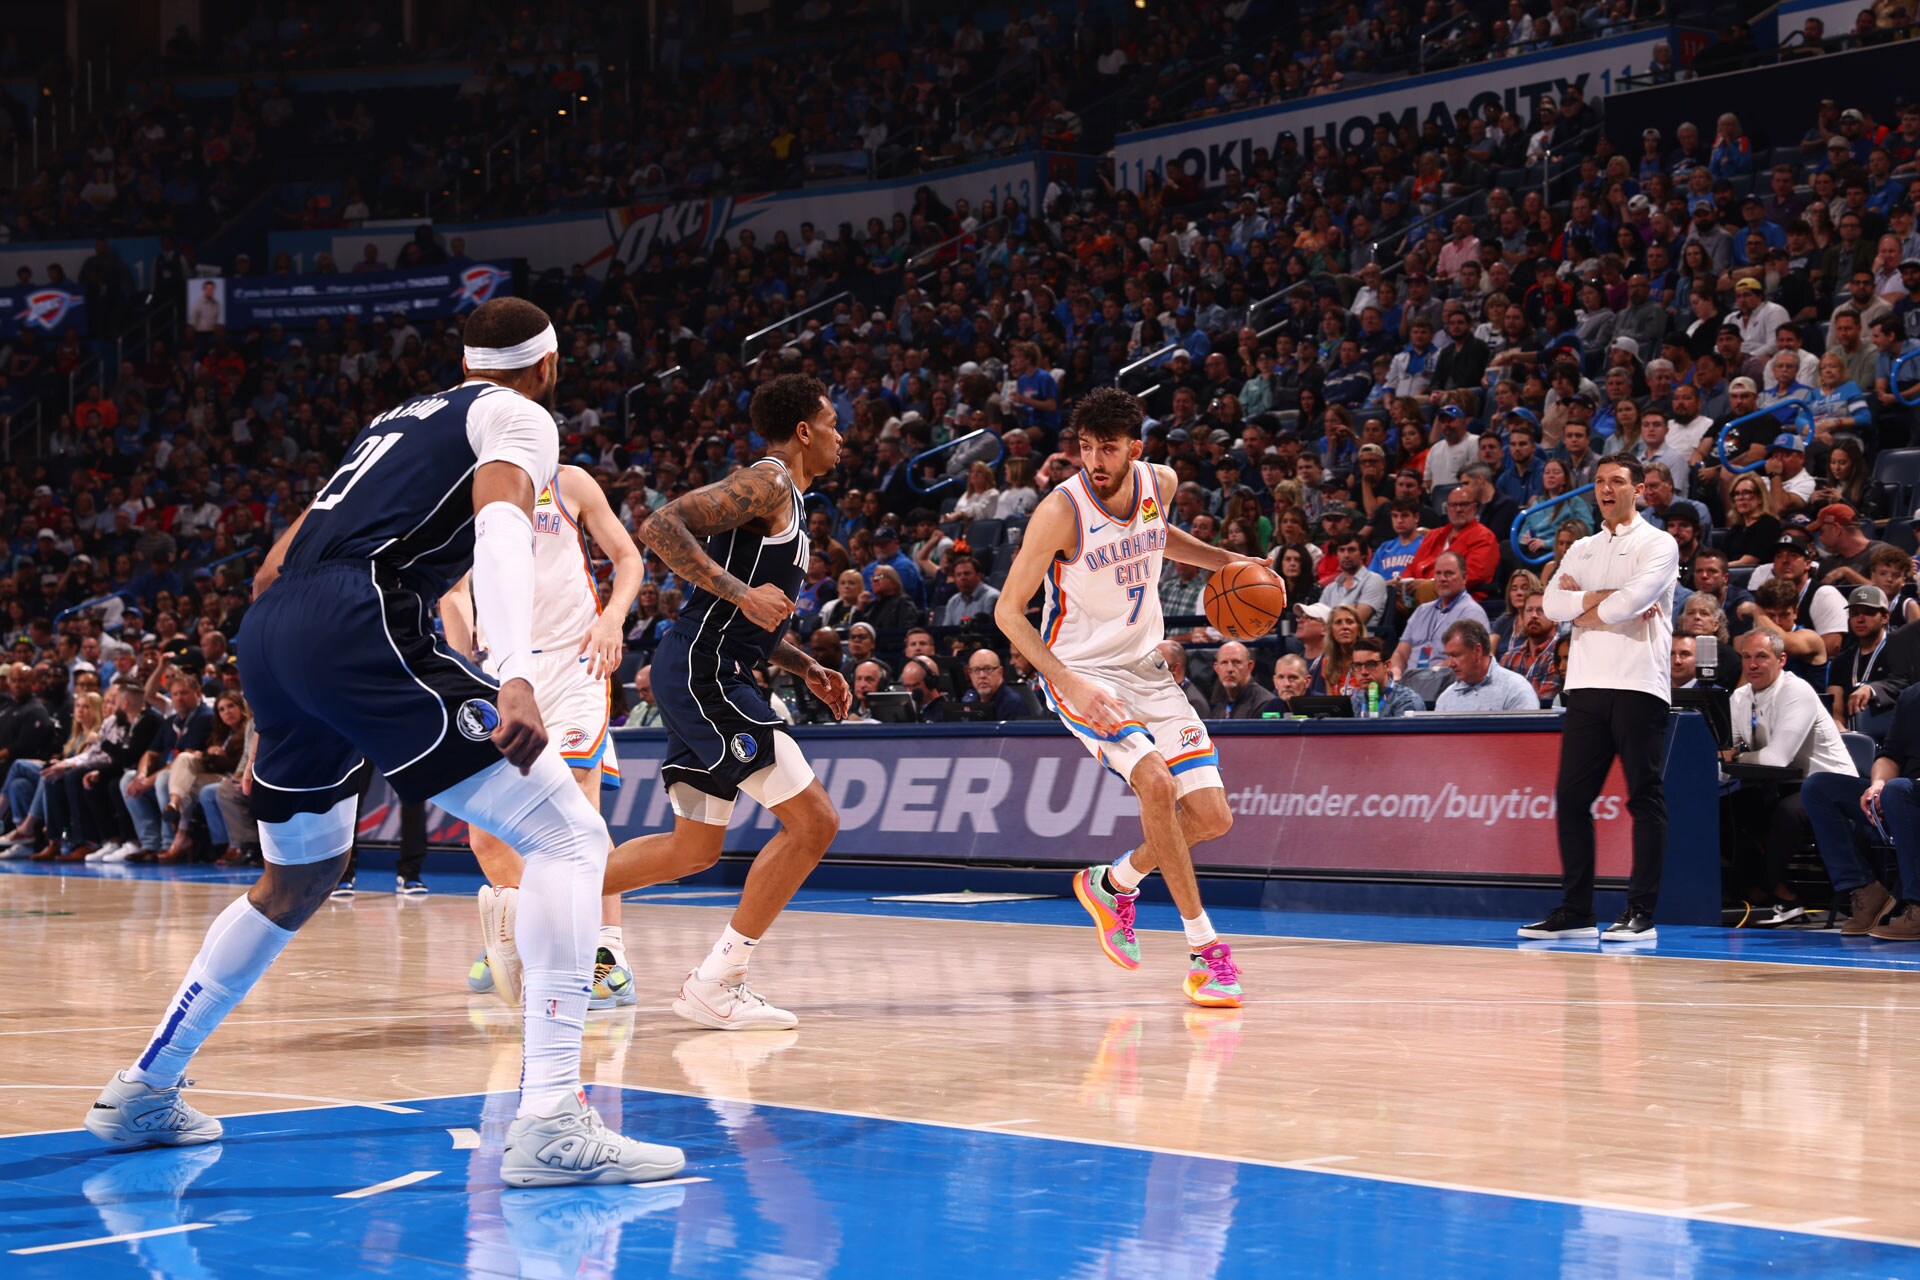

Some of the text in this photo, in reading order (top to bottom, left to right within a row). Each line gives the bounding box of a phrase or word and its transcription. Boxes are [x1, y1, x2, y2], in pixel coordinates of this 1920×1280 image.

[1468, 74, 1590, 126] CITY
[616, 199, 706, 276] OKC
[311, 433, 404, 510] 21
[1084, 527, 1167, 572] OKLAHOMA
[1115, 556, 1151, 586] CITY
[1381, 554, 1414, 570] THUNDE
[1127, 583, 1147, 626] 7
[610, 757, 1013, 832] TDER
[1228, 783, 1621, 826] cthunder.com/buyticts
[133, 1106, 189, 1131] AIR
[536, 1134, 622, 1171] AIR
